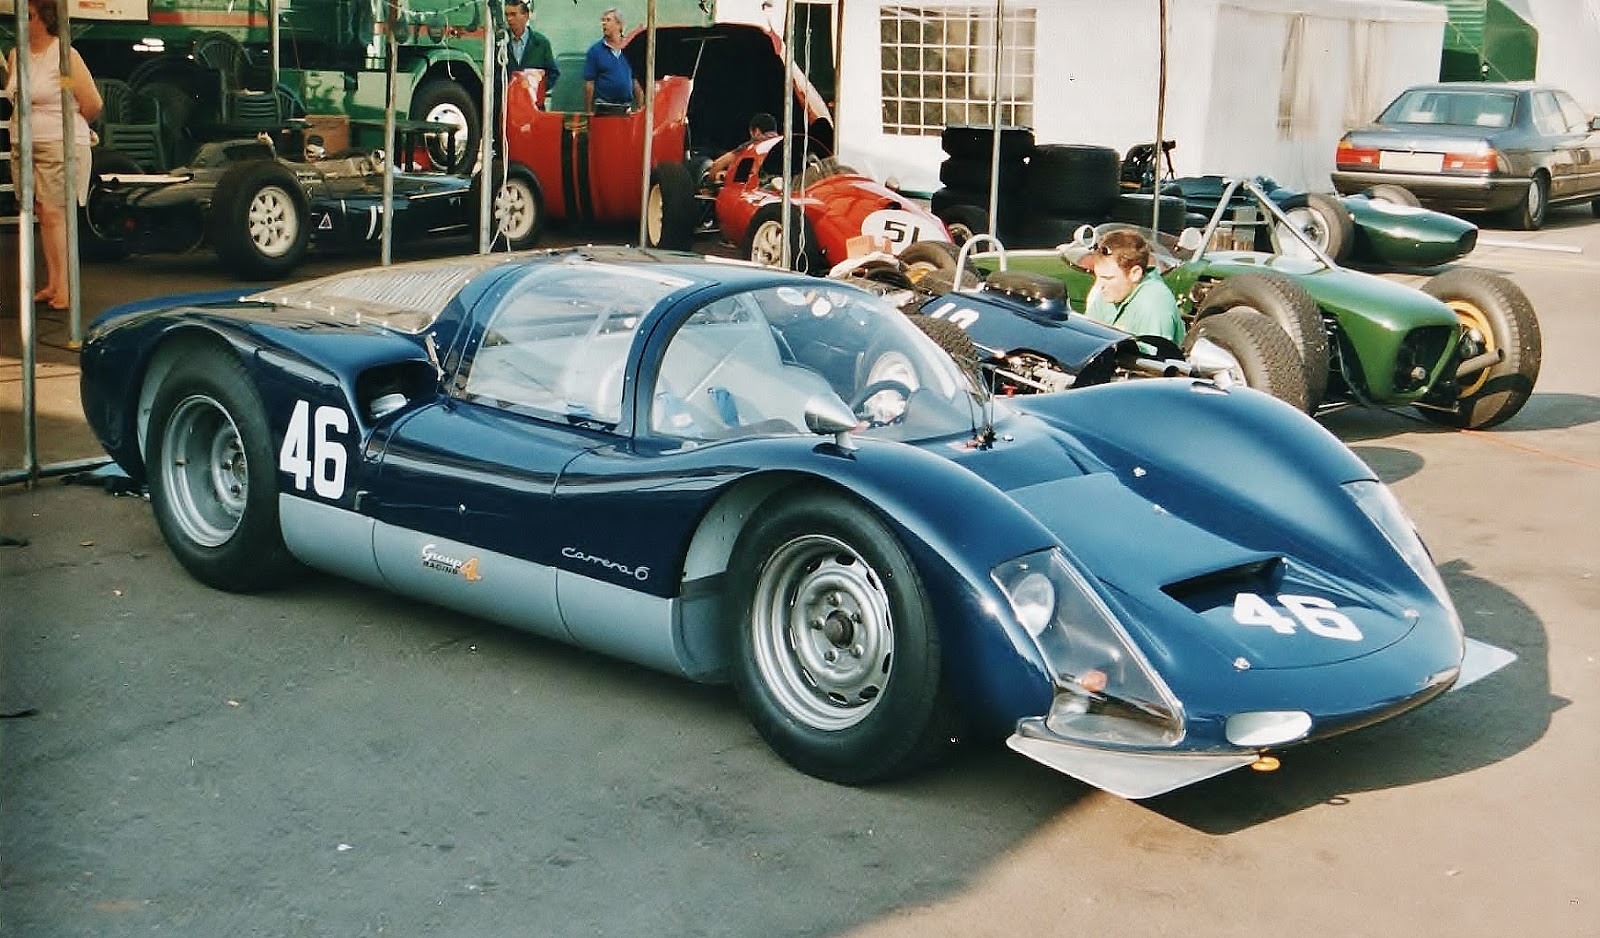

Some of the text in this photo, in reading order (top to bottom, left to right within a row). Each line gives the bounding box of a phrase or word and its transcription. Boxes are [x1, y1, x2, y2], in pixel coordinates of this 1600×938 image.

[884, 220, 920, 244] 51
[280, 399, 349, 500] 46
[422, 543, 482, 581] Group 4
[561, 547, 651, 581] Carrera 6
[1233, 592, 1364, 641] 46
